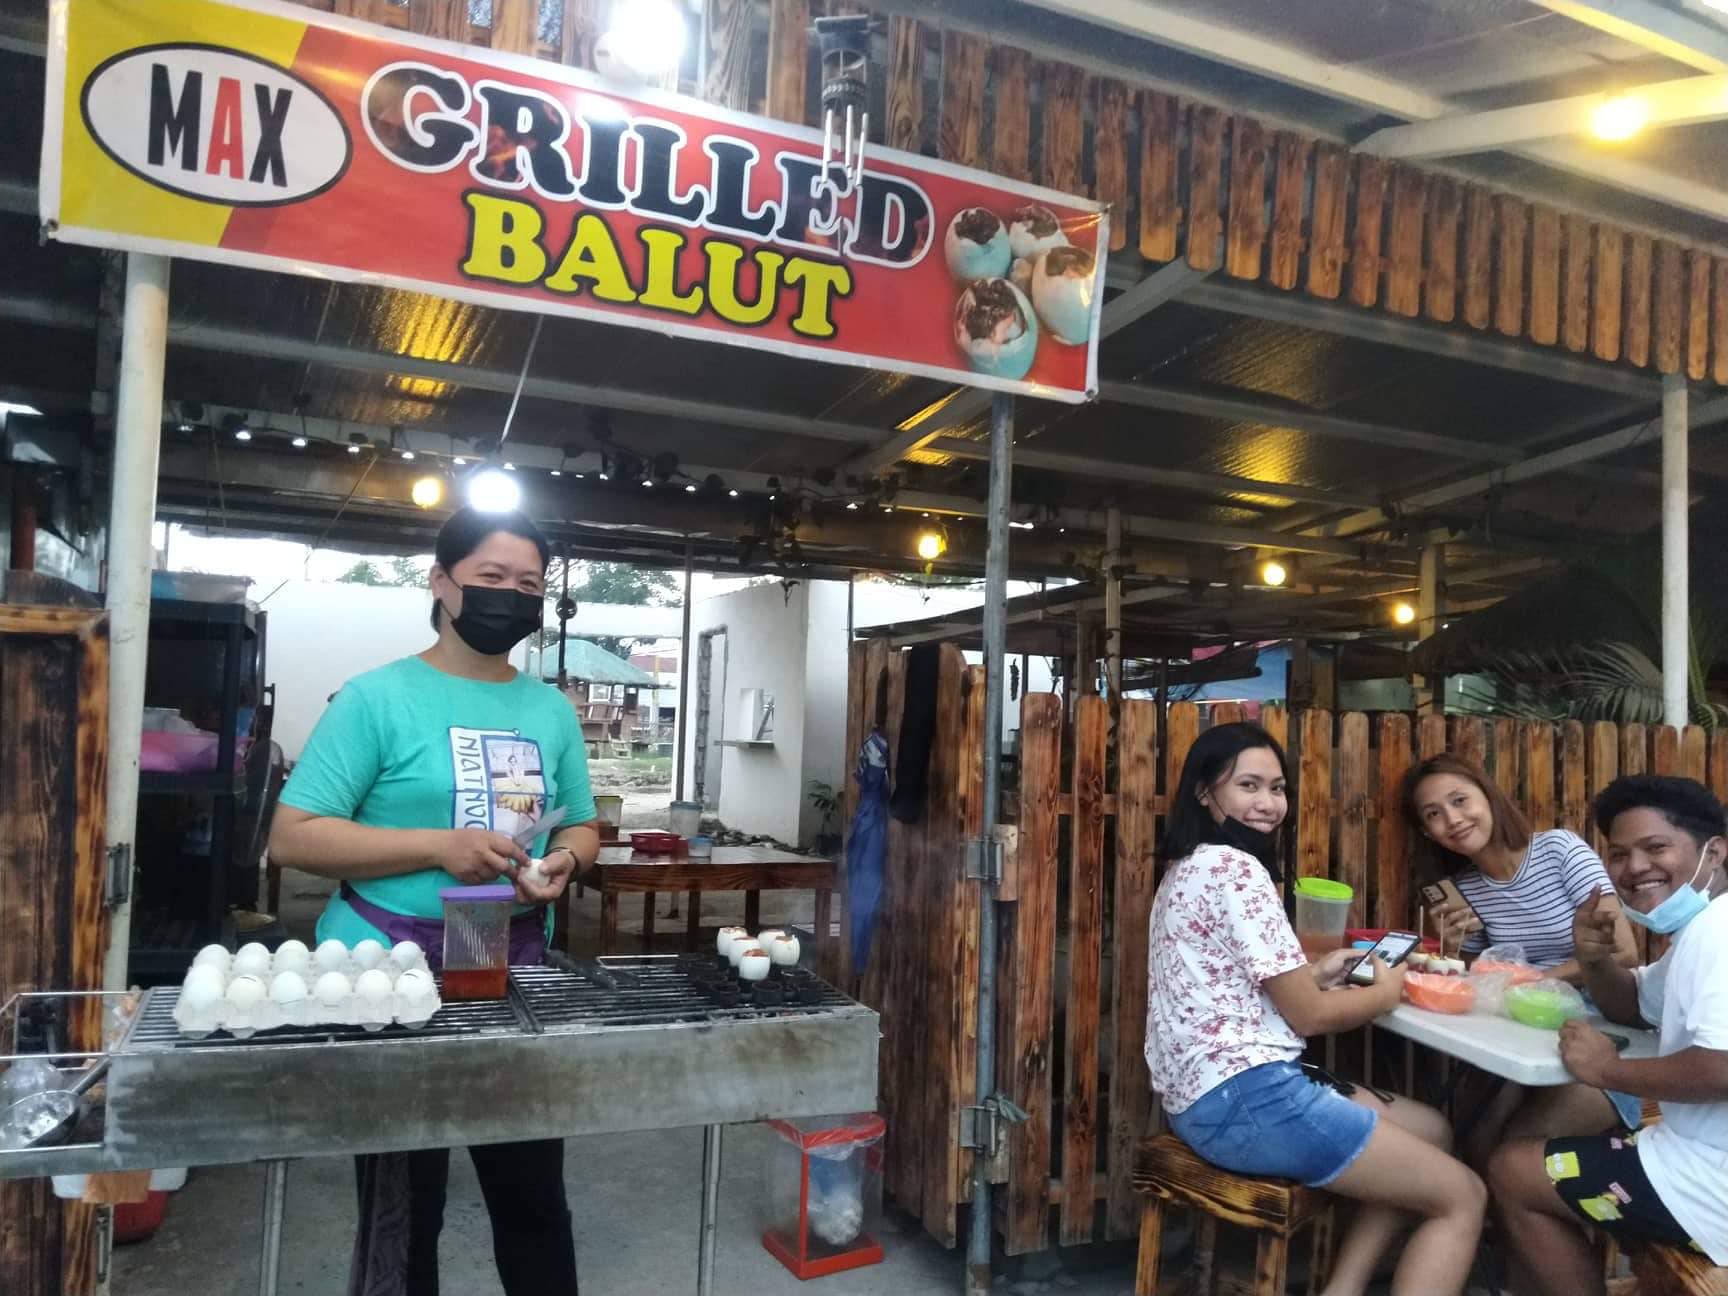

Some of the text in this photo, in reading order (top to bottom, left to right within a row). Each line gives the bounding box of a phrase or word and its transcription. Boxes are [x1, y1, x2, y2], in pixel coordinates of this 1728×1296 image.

[147, 63, 293, 188] MAX
[361, 61, 934, 268] GRILLED
[458, 189, 852, 341] BALUT
